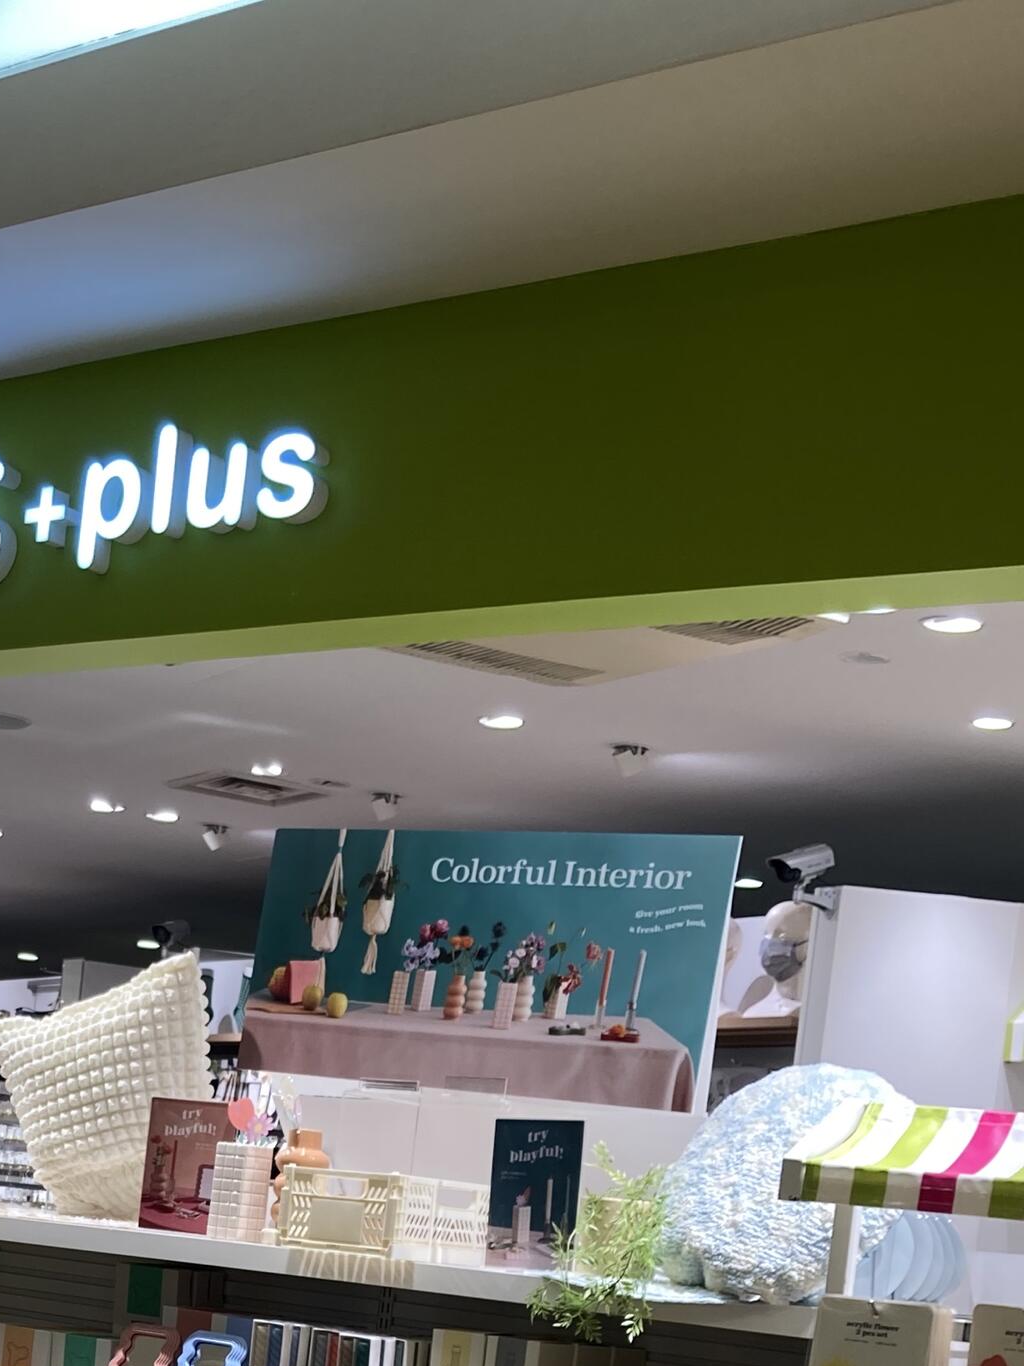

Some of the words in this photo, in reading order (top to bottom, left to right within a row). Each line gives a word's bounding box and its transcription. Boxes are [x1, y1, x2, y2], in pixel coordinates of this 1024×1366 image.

[430, 857, 557, 887] Colorful
[560, 860, 692, 890] Interior
[655, 906, 677, 919] your
[678, 903, 704, 912] room
[181, 1107, 203, 1120] try
[163, 1121, 217, 1139] playful!
[527, 1129, 550, 1143] try
[508, 1144, 565, 1164] playful!
